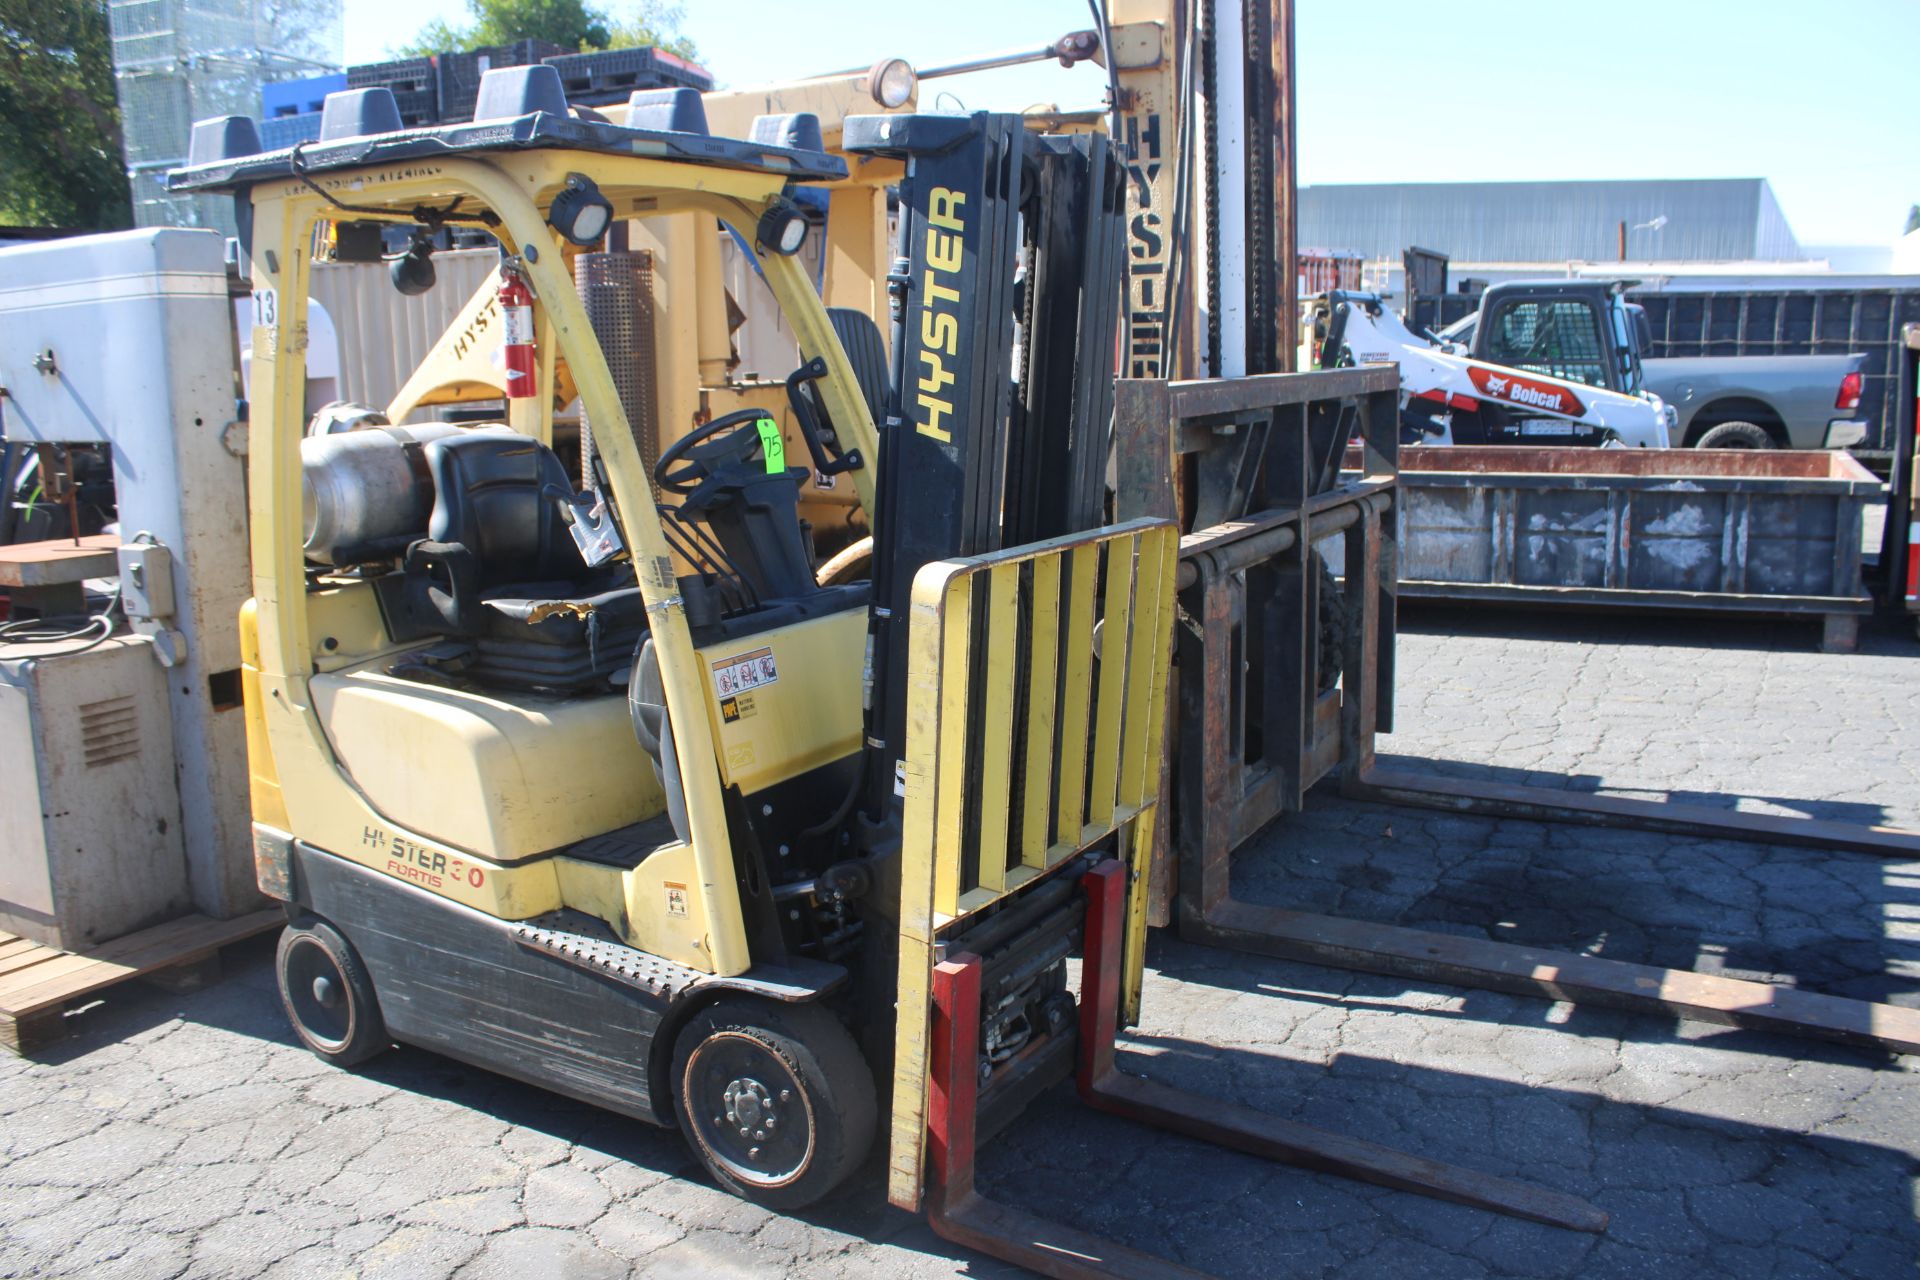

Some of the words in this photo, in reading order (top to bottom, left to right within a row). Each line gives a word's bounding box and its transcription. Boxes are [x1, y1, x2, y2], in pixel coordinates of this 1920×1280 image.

[254, 290, 275, 325] 13
[453, 285, 500, 361] HYST
[916, 186, 966, 443] HYSTER
[1510, 383, 1562, 410] Bobcat
[763, 434, 782, 458] 75
[386, 860, 443, 889] FORTIS
